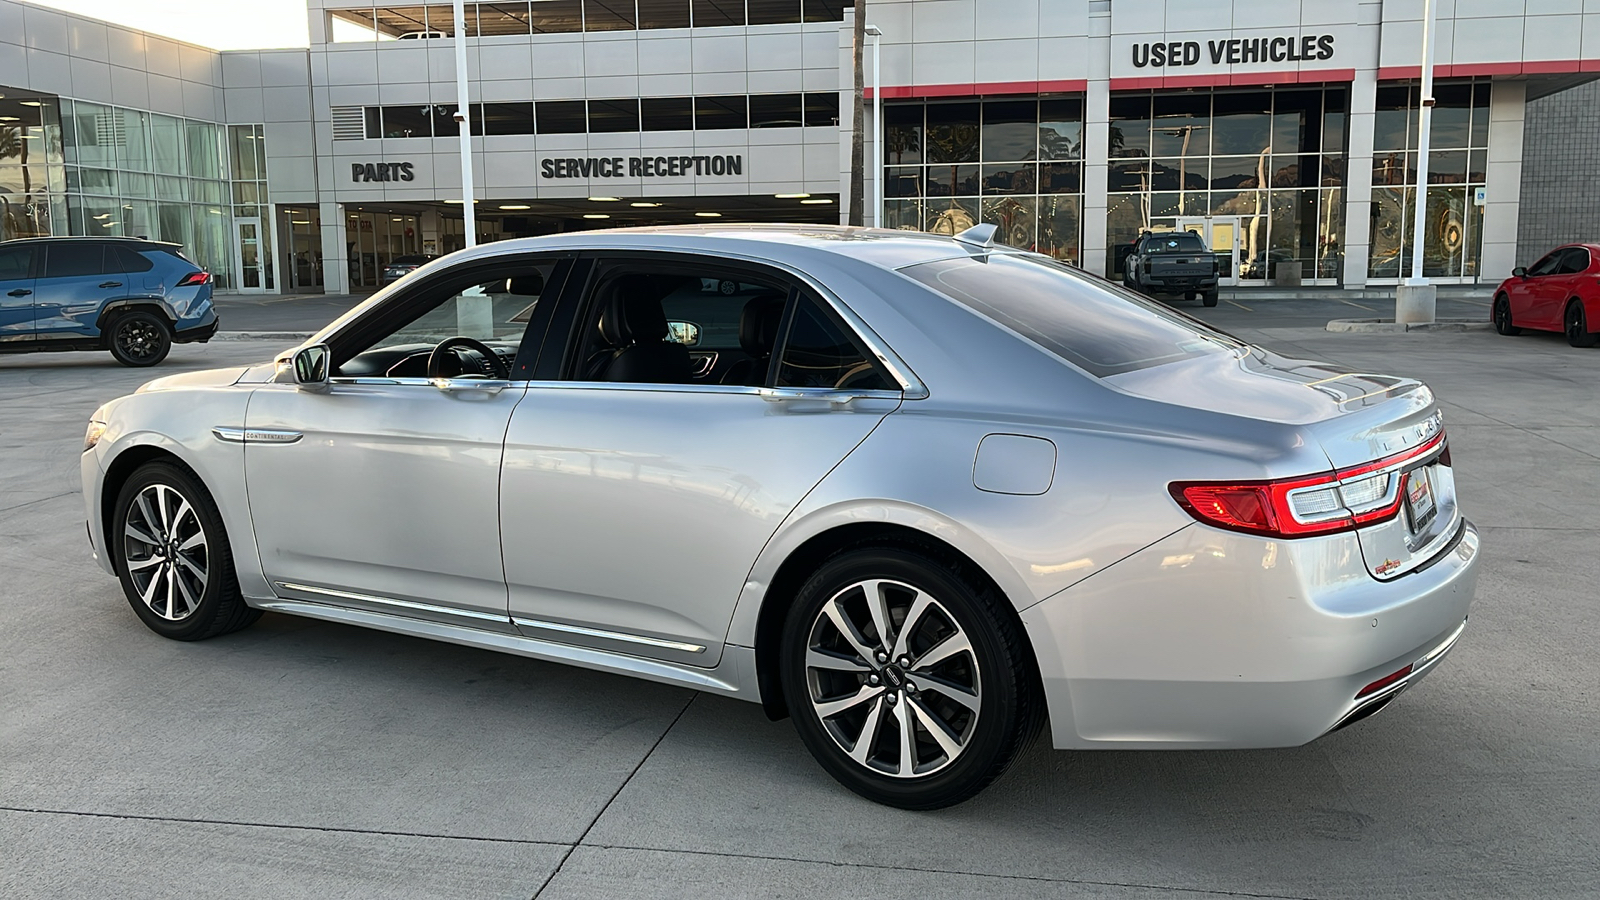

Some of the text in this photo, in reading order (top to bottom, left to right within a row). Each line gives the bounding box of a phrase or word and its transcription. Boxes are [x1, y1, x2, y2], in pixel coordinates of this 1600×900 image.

[1132, 35, 1334, 68] USED VEHICLES
[352, 162, 414, 182] PARTS
[541, 155, 742, 178] SERVICE RECEPTION
[348, 220, 373, 230] TOOTA
